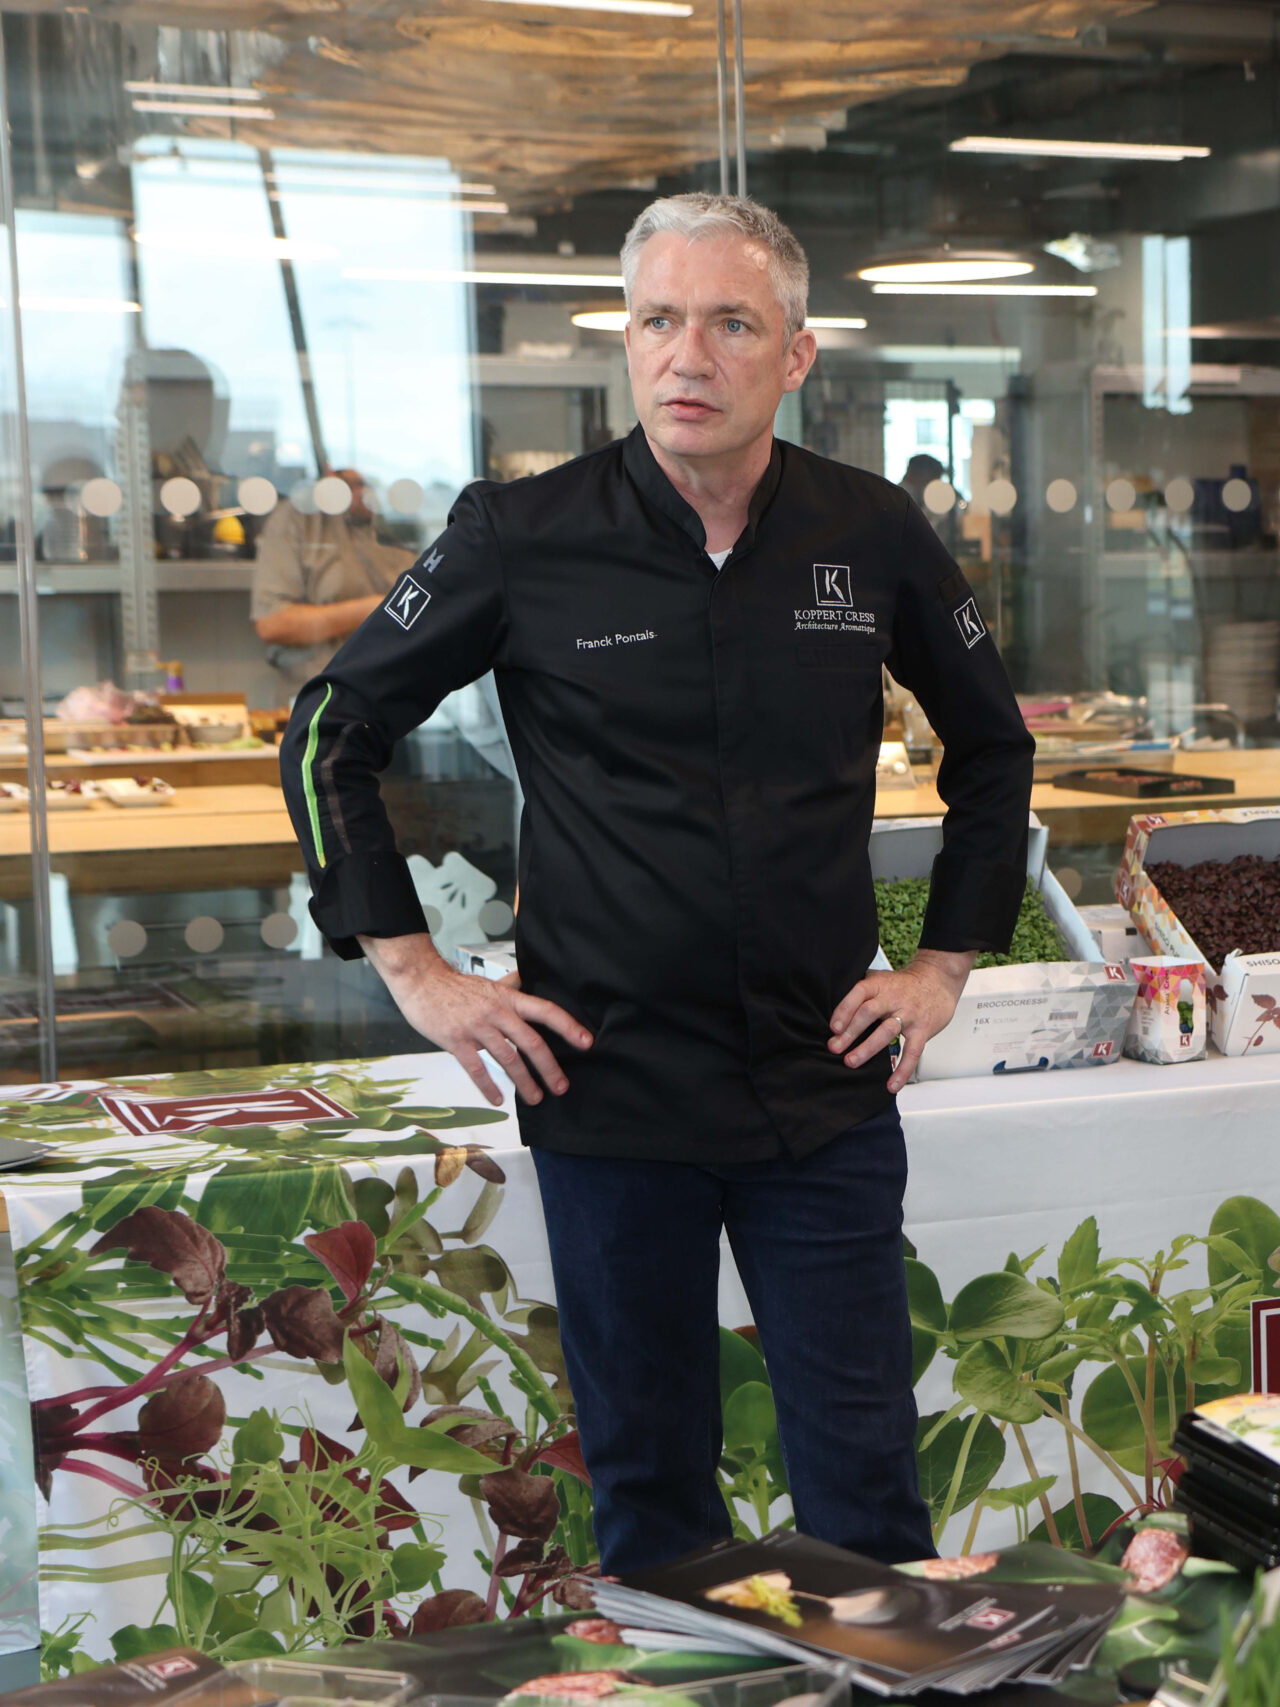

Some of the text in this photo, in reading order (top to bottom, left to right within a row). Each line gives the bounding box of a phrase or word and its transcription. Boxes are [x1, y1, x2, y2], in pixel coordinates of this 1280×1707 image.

[794, 609, 875, 623] KOPPERT CRESS
[794, 621, 876, 634] Architecture Aromatique
[576, 635, 613, 650] Franck
[1247, 958, 1280, 967] SHISO
